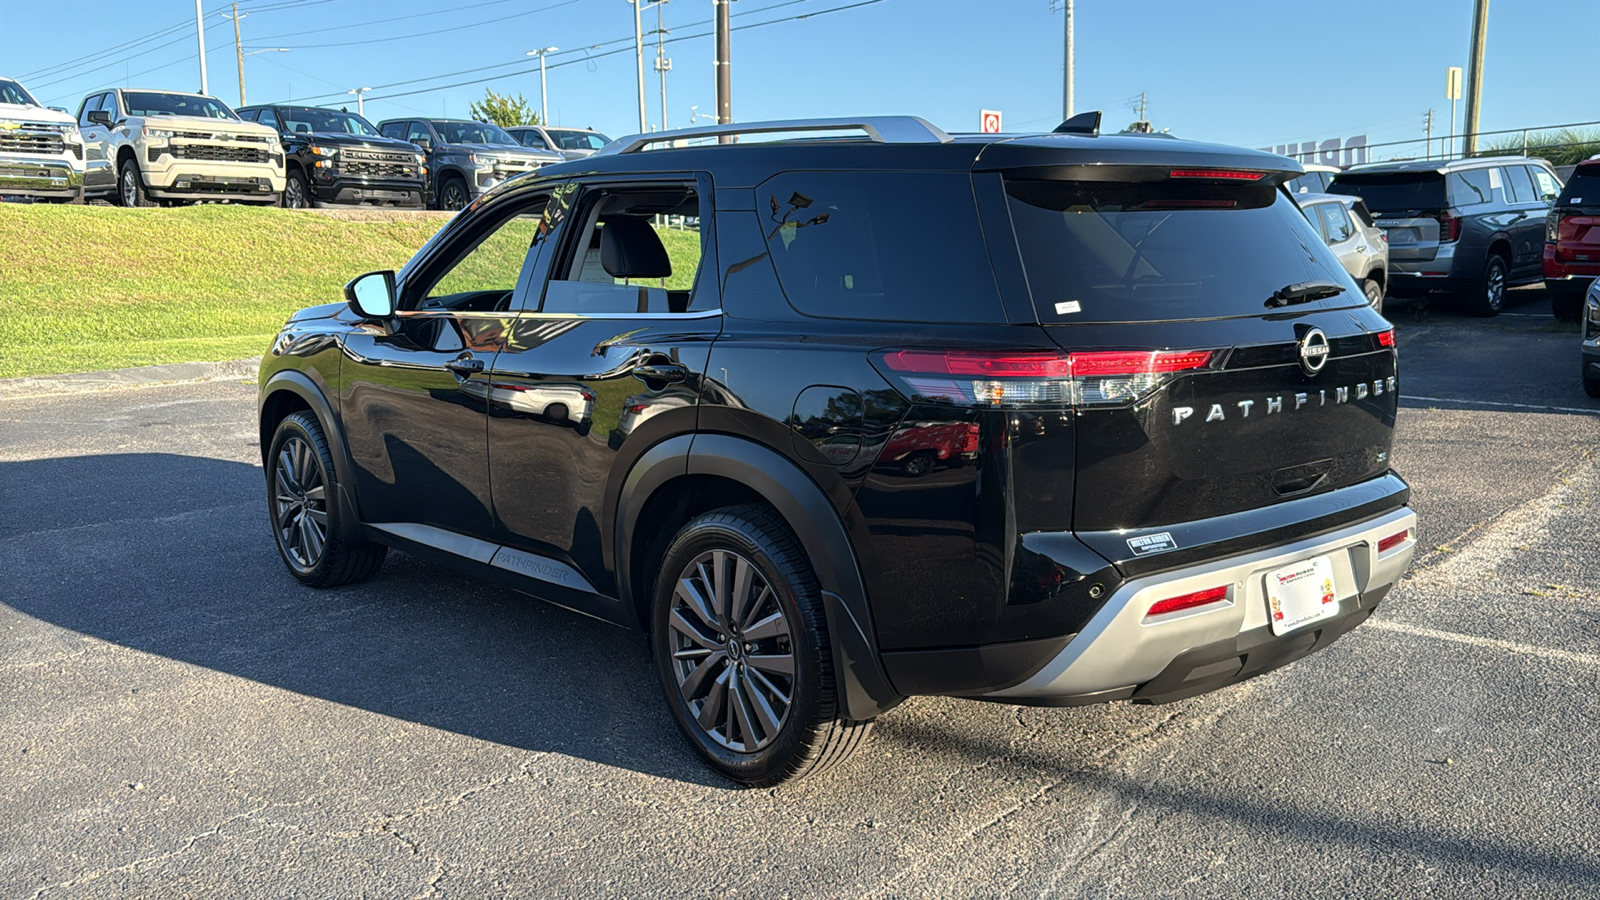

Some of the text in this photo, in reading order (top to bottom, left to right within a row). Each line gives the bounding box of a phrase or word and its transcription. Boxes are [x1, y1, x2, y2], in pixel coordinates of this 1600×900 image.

[1301, 346, 1329, 356] NISSAN
[1172, 376, 1396, 425] PATHFINDER
[496, 552, 569, 581] PATHFINDER
